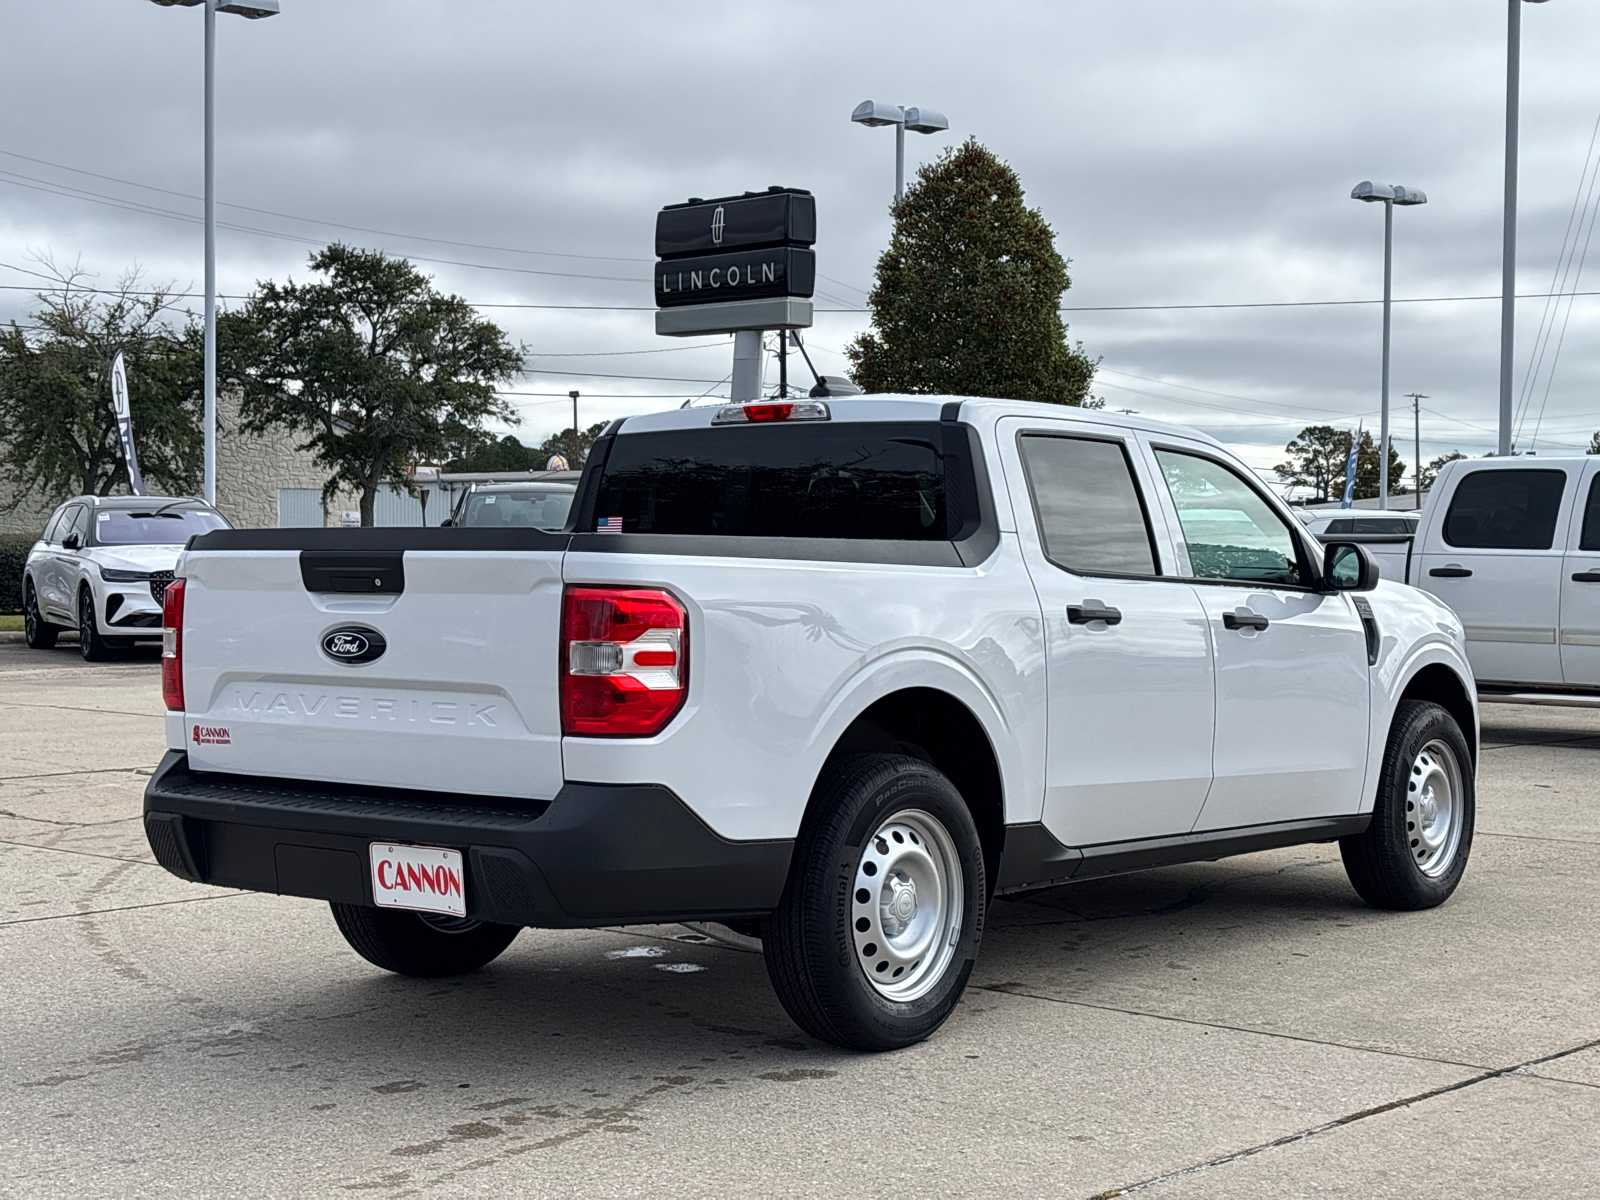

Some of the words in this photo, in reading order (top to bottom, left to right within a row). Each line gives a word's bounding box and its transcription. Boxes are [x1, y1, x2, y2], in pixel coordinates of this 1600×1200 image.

[662, 261, 775, 293] LINCOLN
[331, 635, 360, 652] Ford
[232, 690, 498, 727] MAVERICK
[200, 726, 230, 738] CANNON
[377, 859, 461, 899] CANNON
[834, 874, 852, 969] Continental
